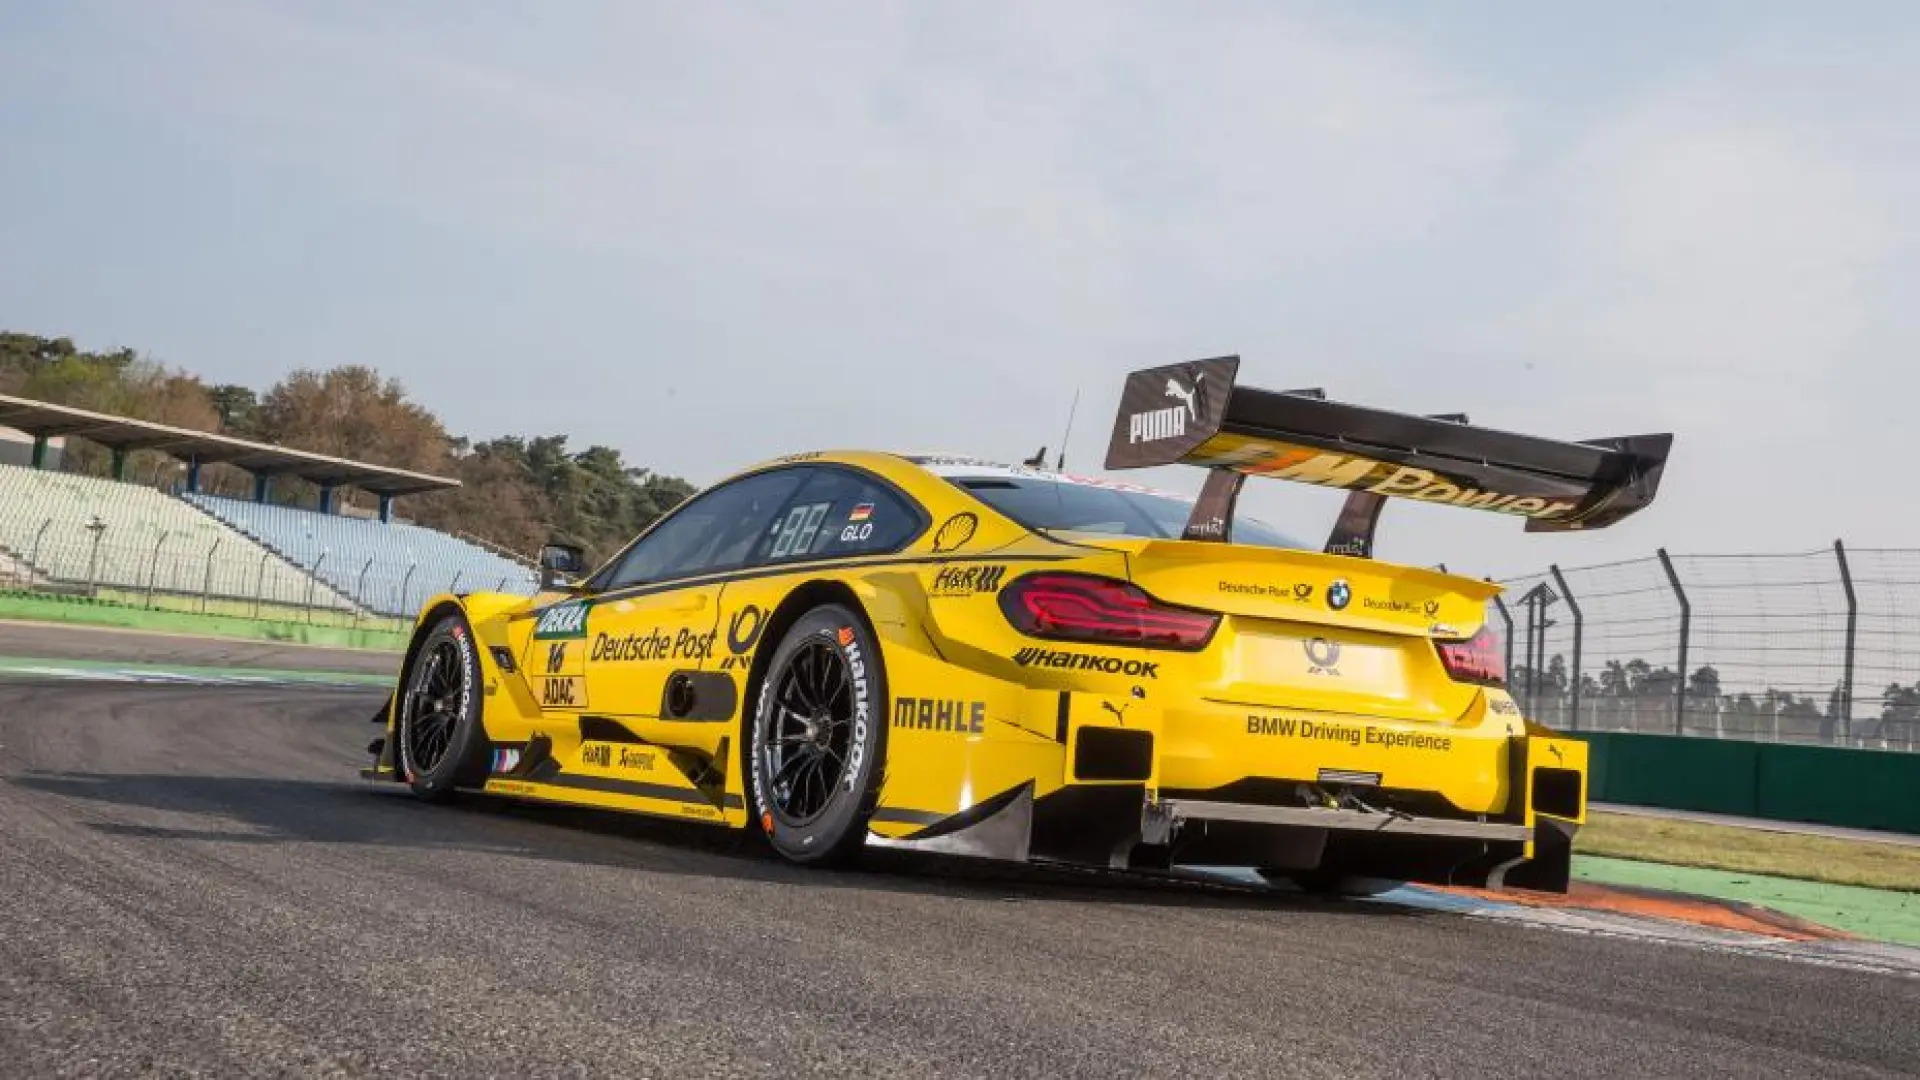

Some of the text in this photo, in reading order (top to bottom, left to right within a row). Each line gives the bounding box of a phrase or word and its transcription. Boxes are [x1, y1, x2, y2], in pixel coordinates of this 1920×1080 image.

[1130, 405, 1185, 444] PUMA
[1367, 466, 1576, 518] Power
[841, 523, 873, 541] GLO
[1218, 581, 1290, 597] Deutsche Post
[590, 627, 718, 661] Deutsche Post
[543, 678, 574, 705] ADAC
[894, 696, 986, 734] MAHLE
[1247, 715, 1450, 751] BMW Driving Experience
